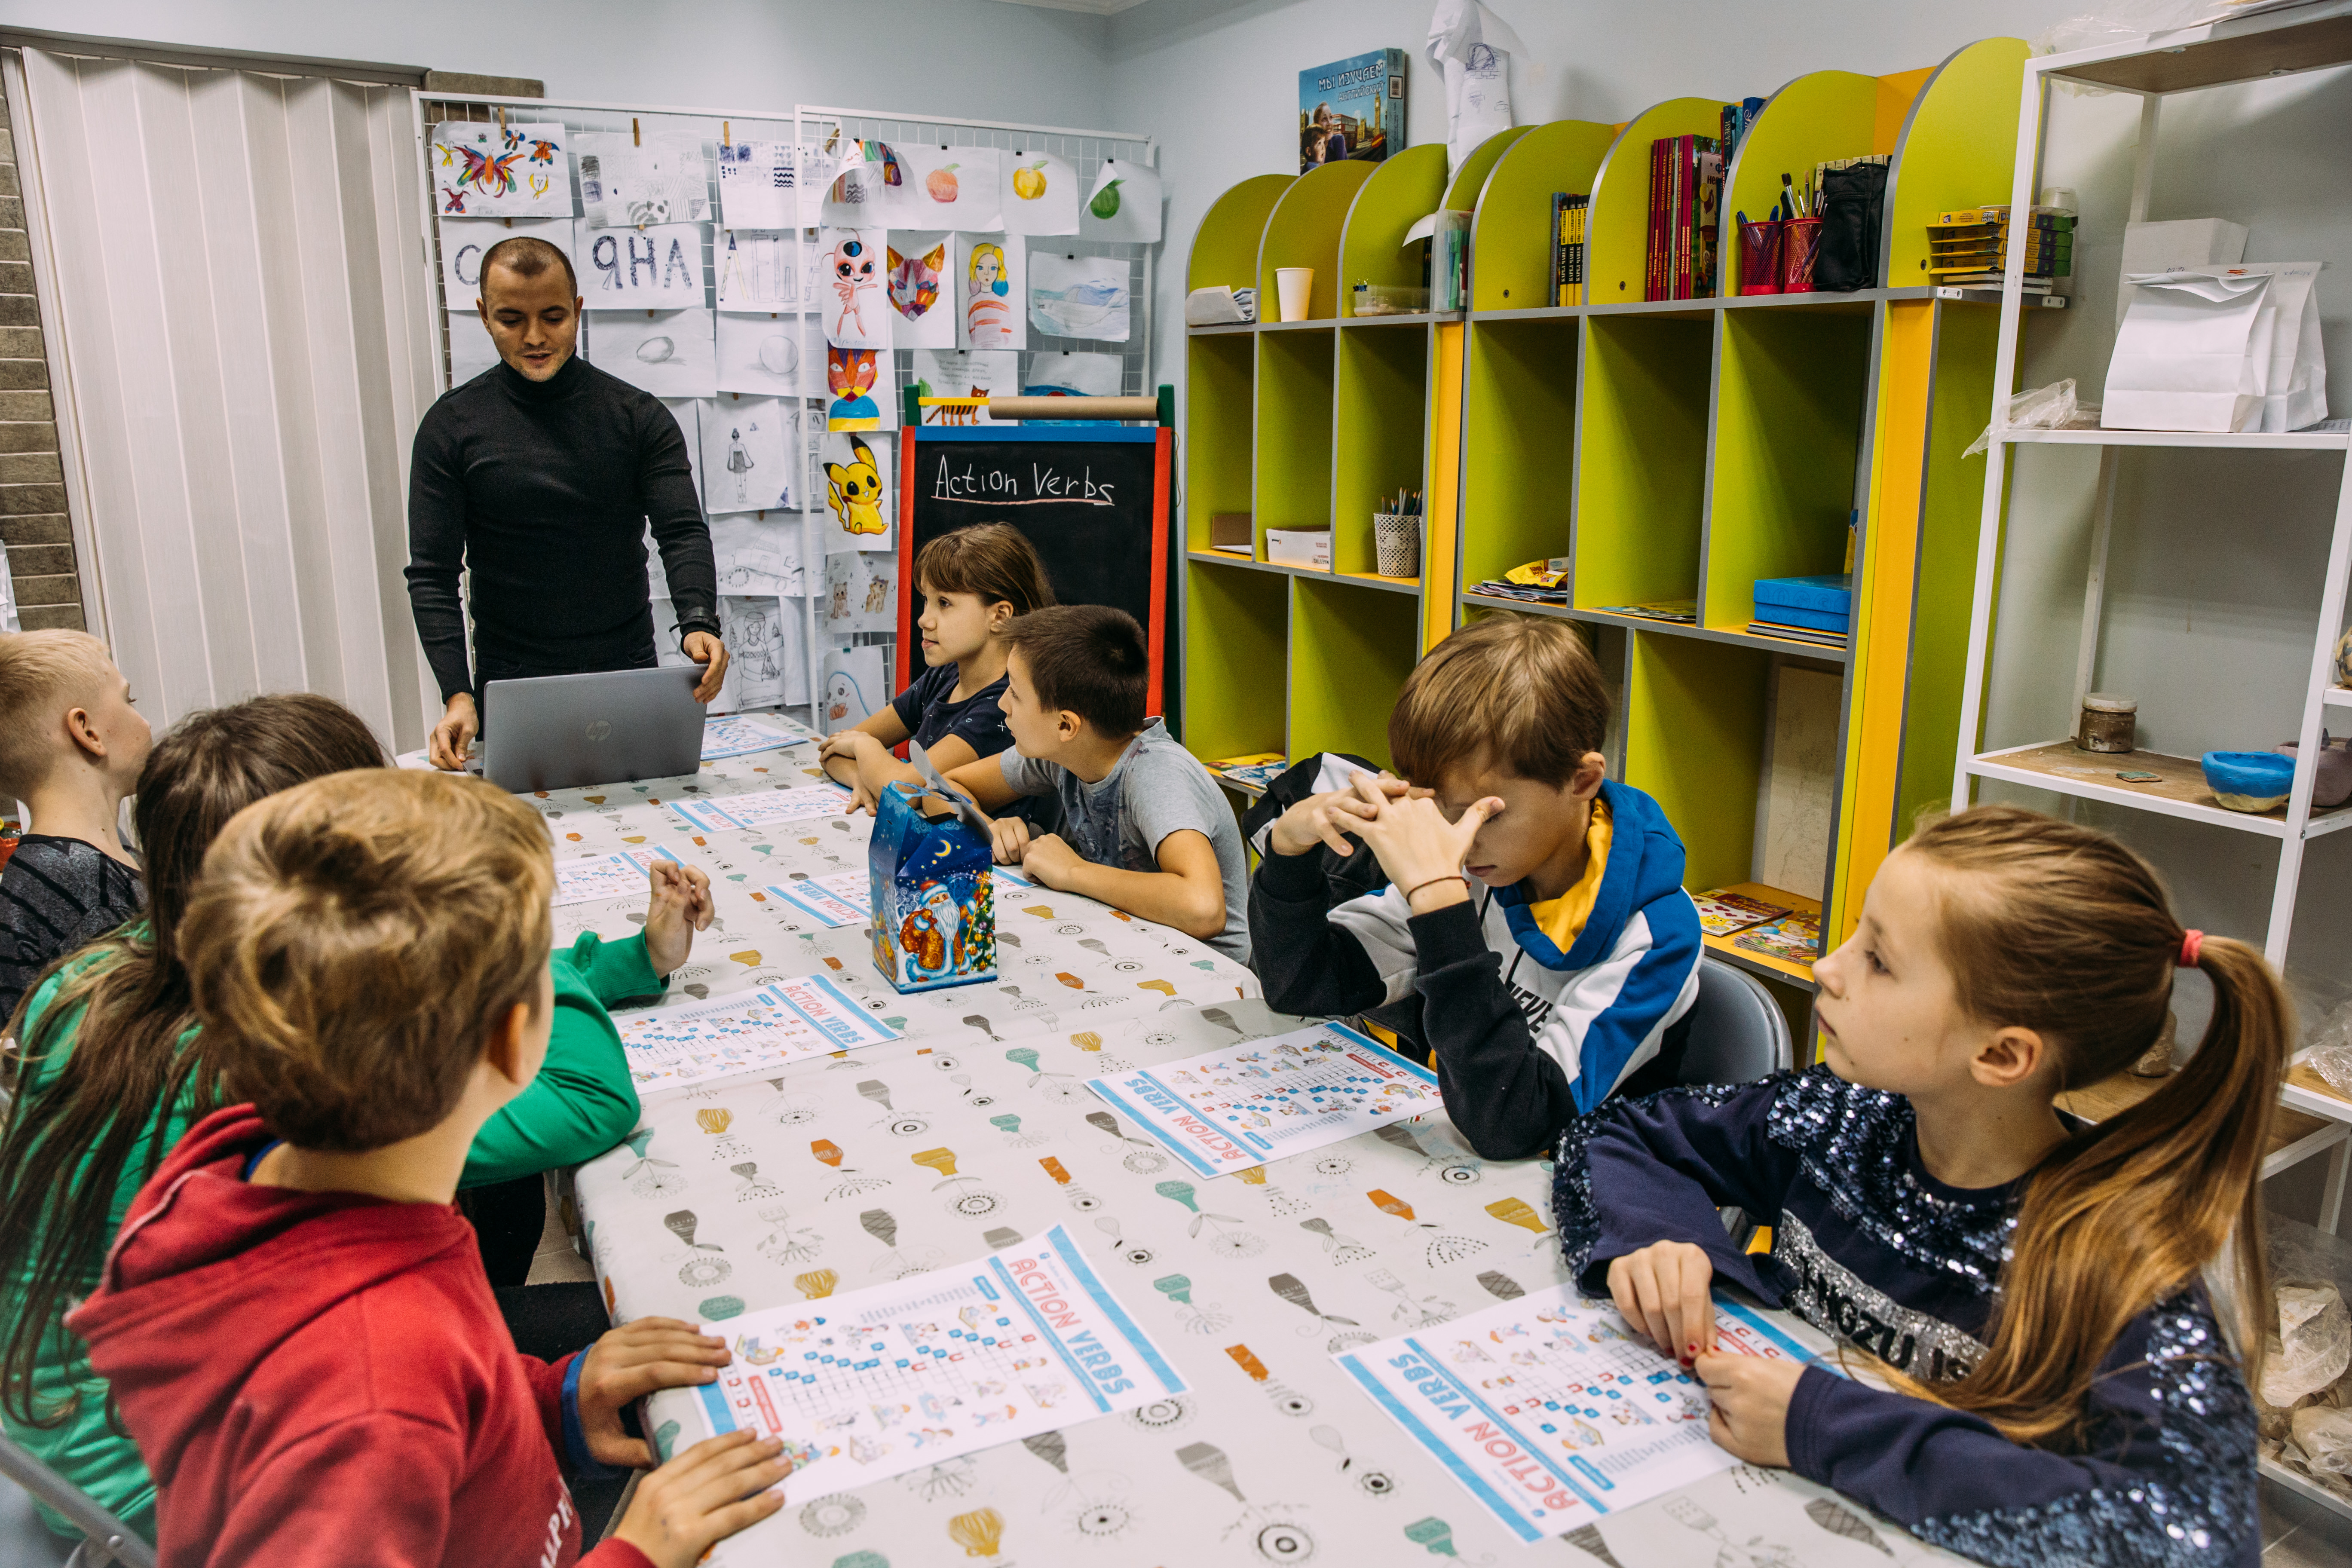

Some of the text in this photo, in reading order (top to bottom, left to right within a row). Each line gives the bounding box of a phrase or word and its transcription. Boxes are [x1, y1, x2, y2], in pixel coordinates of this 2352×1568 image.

[1319, 62, 1383, 92] МЫ ИЗУЧАЕМ
[1338, 80, 1384, 102] АНГЛИЙСКИЙ
[592, 235, 692, 291] ЯНА
[936, 454, 1115, 503] Action Verbs
[792, 884, 864, 919] ACTION VERBS
[781, 986, 831, 1017] ACTION
[820, 1016, 866, 1044] VERBS
[1124, 1078, 1180, 1115] VERBS
[1172, 1115, 1247, 1160] ACTION
[1008, 1258, 1136, 1394] ACTION VERBS
[1387, 1353, 1471, 1421] VERBS
[1463, 1421, 1580, 1510] ACTION
